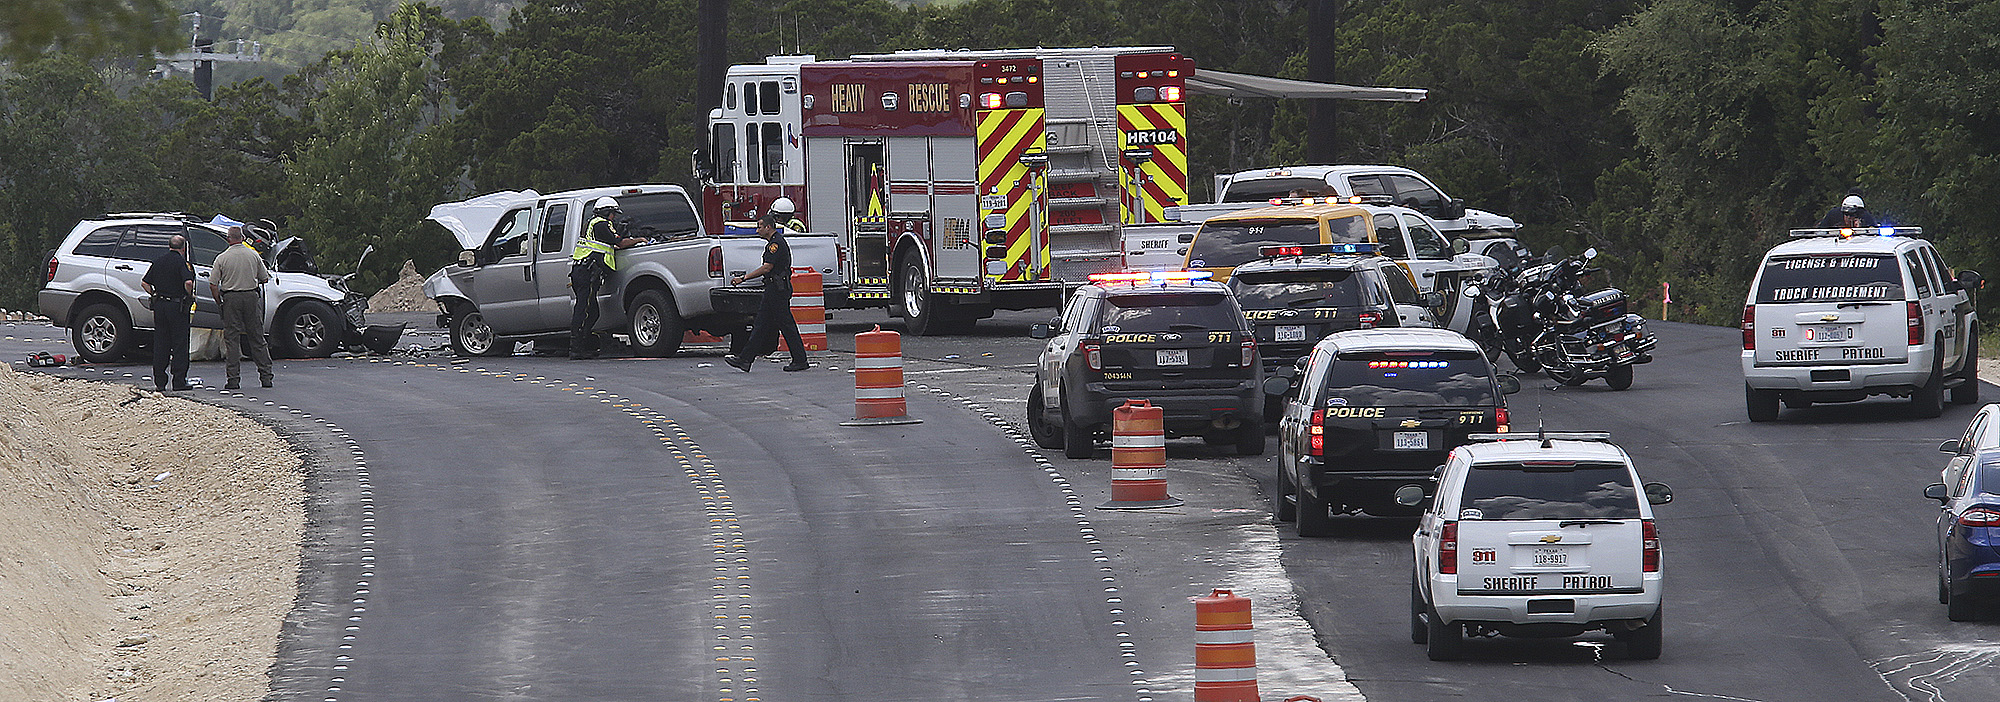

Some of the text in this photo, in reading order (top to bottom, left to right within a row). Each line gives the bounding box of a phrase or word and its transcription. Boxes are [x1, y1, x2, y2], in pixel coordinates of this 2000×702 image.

[831, 84, 950, 112] HEAVY RESCUE
[1127, 130, 1177, 144] HR104
[1249, 226, 1265, 234] 911
[1141, 239, 1169, 249] SHERIFF
[1785, 258, 1880, 270] LICENSE & WEIGHT
[1774, 286, 1888, 301] TRUCK ENFORCEMENT
[1593, 293, 1621, 306] SHERIFF
[1243, 310, 1337, 320] LICE 911
[1106, 333, 1232, 344] POLICE 911
[1771, 329, 1786, 337] 911
[1776, 347, 1886, 361] SHERIFF PATROL
[1326, 407, 1386, 418] POLICE
[1459, 415, 1484, 424] 911
[1472, 550, 1497, 562] 911
[1534, 554, 1568, 564] 118-9917
[1483, 576, 1614, 590] SHERIFF PATROL
